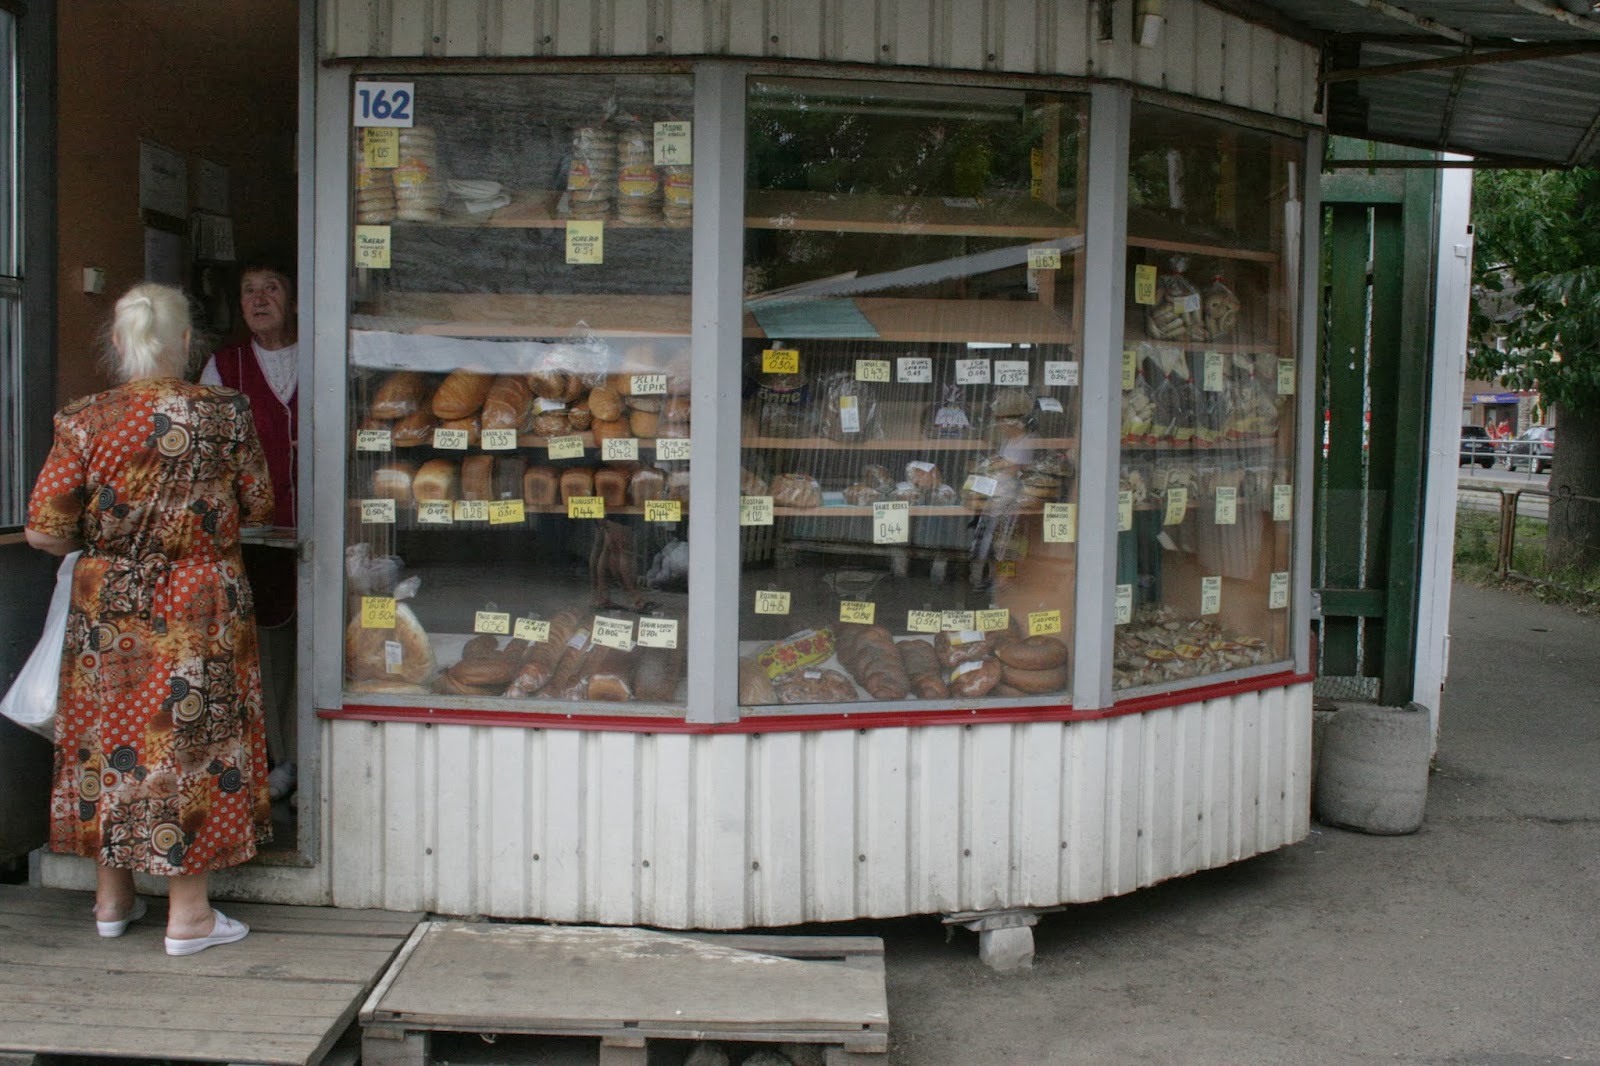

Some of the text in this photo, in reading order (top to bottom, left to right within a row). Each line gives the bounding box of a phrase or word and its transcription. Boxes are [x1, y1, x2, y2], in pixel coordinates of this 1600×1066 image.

[358, 89, 411, 120] 162
[636, 383, 667, 393] SEPIK
[436, 430, 455, 438] LAADA
[607, 439, 632, 448] SEPIK
[570, 497, 597, 506] AUGUSTI
[910, 611, 942, 619] PALMIK
[640, 621, 656, 629] SUUR
